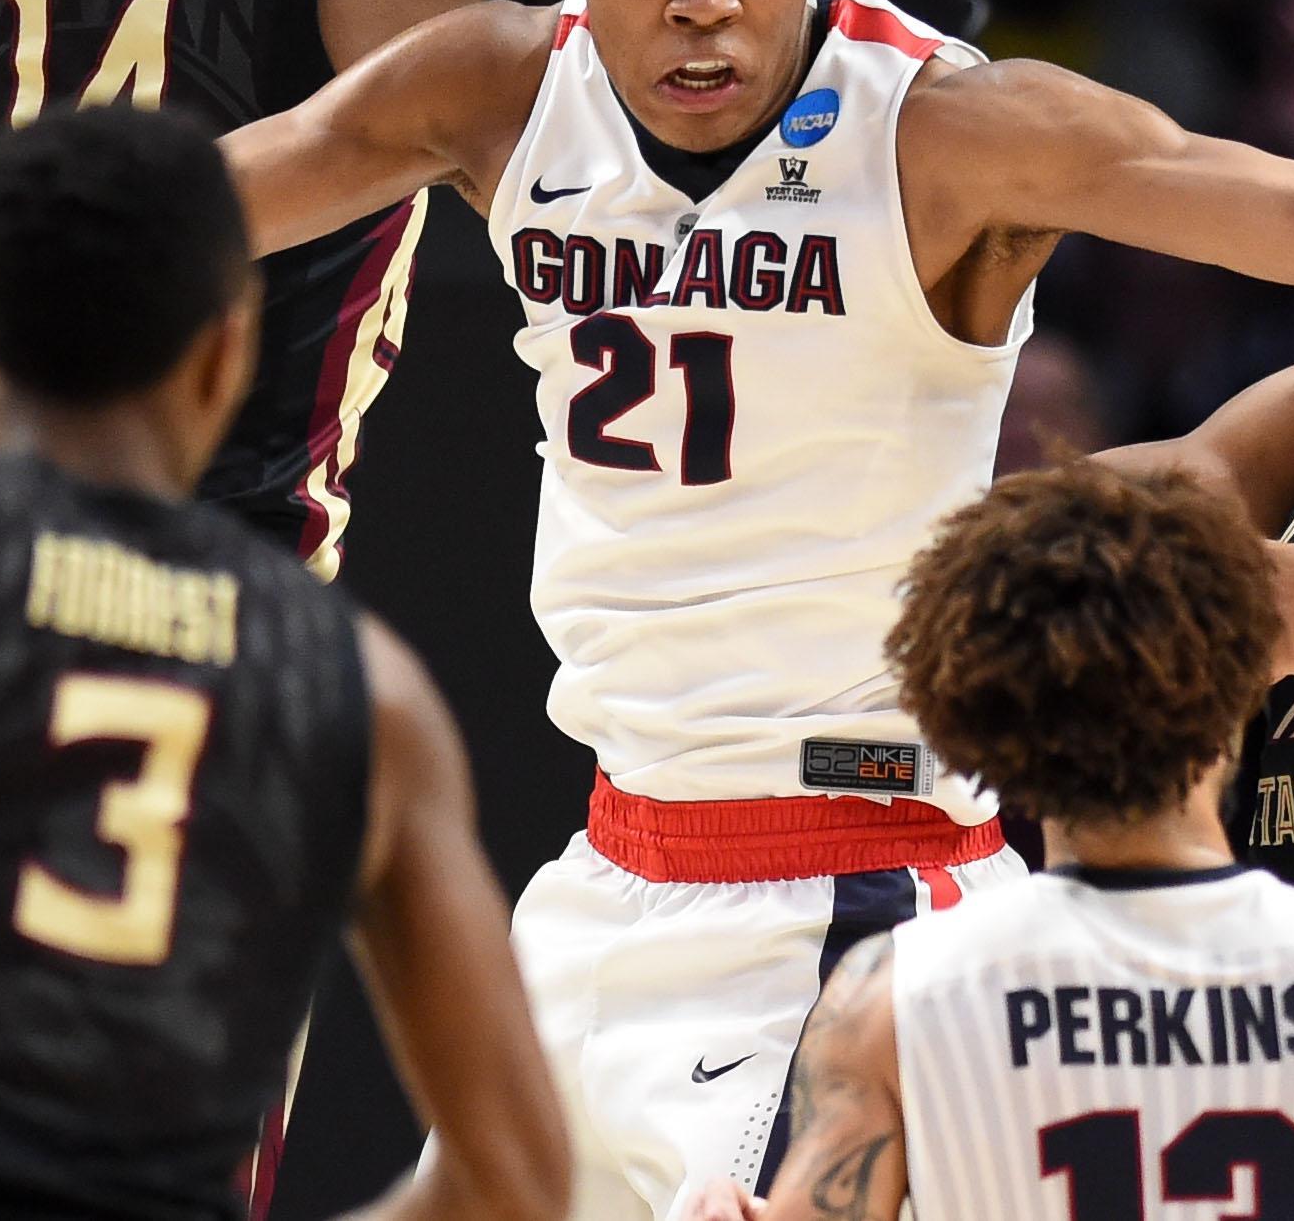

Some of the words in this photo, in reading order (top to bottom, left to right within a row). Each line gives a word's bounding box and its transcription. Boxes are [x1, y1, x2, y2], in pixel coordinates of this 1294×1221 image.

[789, 112, 834, 132] NCAA
[511, 227, 846, 317] GONAGA
[567, 311, 735, 486] 21
[809, 747, 855, 773] 52
[860, 746, 914, 764] NIKE
[859, 762, 914, 780] ELITE
[12, 671, 213, 967] 3
